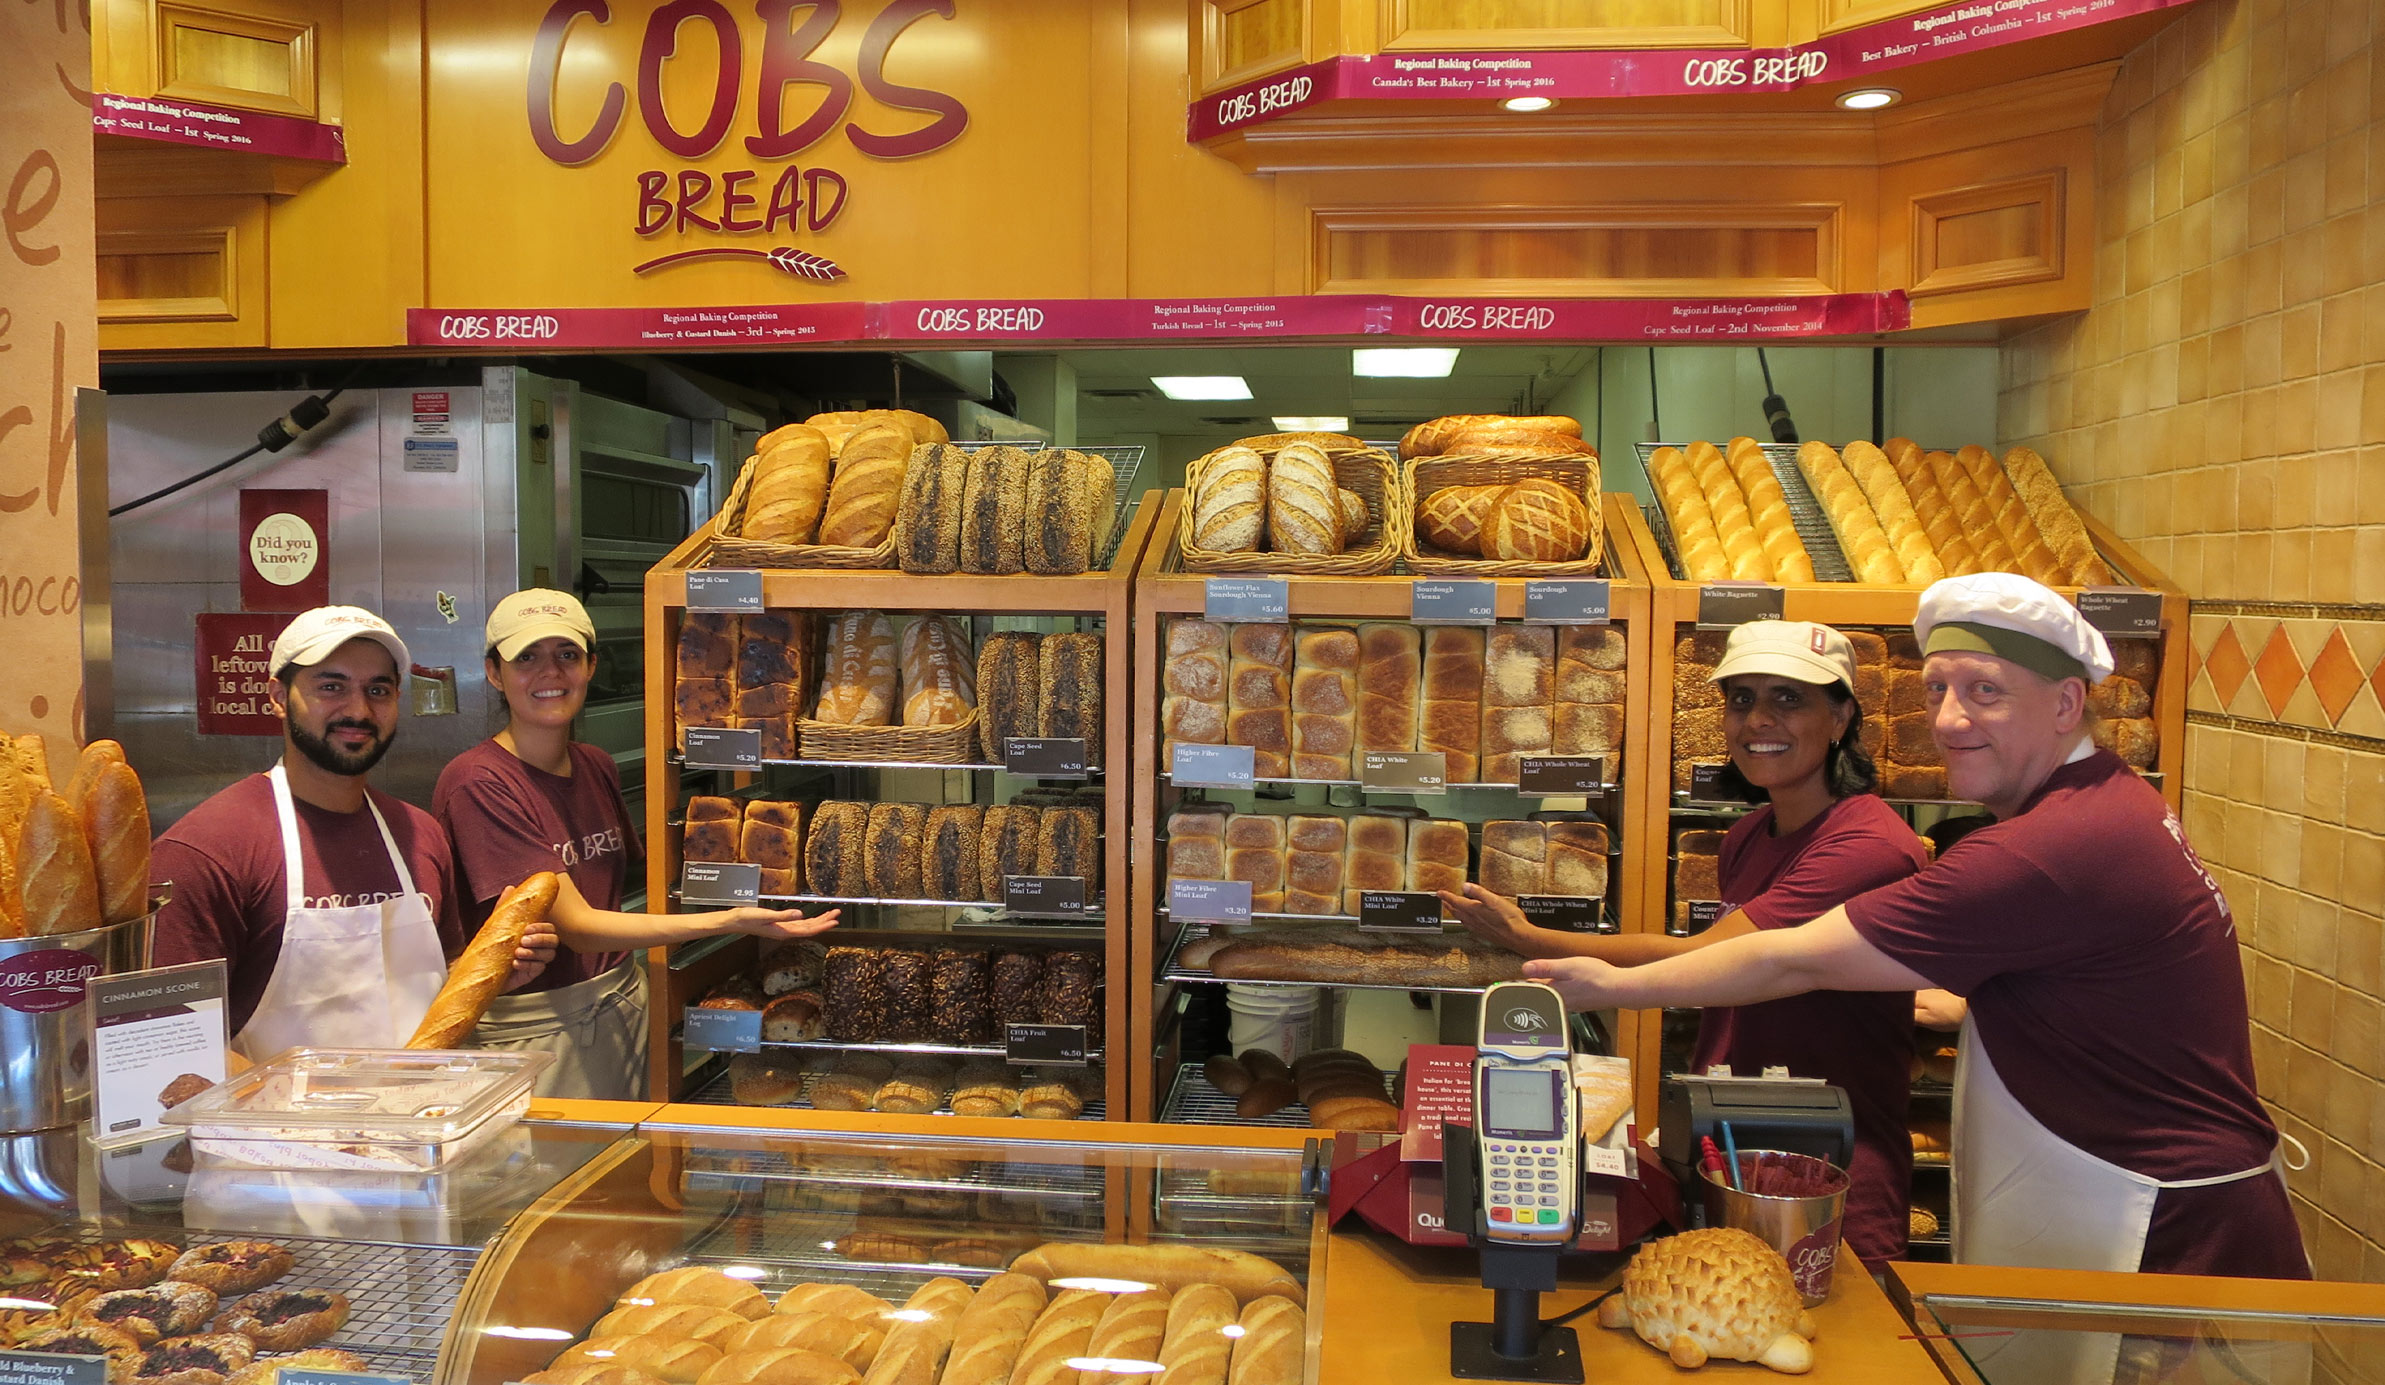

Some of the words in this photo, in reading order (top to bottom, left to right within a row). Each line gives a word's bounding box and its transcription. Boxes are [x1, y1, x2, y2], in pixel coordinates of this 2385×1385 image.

[1913, 13, 1956, 32] Regional
[1957, 4, 1994, 26] Baking
[1861, 51, 1881, 62] Best
[1884, 43, 1918, 57] Bakery
[1932, 29, 1967, 46] British
[1971, 17, 2022, 37] Columbia
[2035, 10, 2052, 23] 1st
[2056, 5, 2087, 20] Spring
[1394, 57, 1435, 71] Regional
[1437, 57, 1470, 71] Baking
[1472, 58, 1531, 71] Competition
[1683, 58, 1746, 86] COBS
[1752, 51, 1827, 85] BREAD
[526, 0, 968, 164] COBS
[1372, 76, 1413, 87] Canada's
[1416, 77, 1436, 87] Best
[1439, 77, 1474, 90] Bakery
[1486, 75, 1501, 87] 1st
[1504, 77, 1531, 89] Spring
[1533, 77, 1554, 86] 2016
[1218, 92, 1255, 125] COBS
[1259, 77, 1312, 113] BREAD
[102, 96, 146, 111] Regional
[147, 102, 181, 118] Baking
[182, 107, 240, 124] Competition
[93, 115, 117, 131] Cape
[119, 118, 144, 129] Seed
[148, 121, 170, 133] Loaf
[184, 125, 198, 137] 1st
[203, 130, 229, 143] Spring
[231, 134, 251, 143] 2016
[634, 164, 850, 236] BREAD
[1154, 304, 1190, 316] Regional
[1192, 304, 1221, 315] Baking
[1223, 302, 1275, 314] Competition
[1672, 305, 1709, 317] Regional
[1712, 304, 1742, 316] Baking
[1743, 302, 1797, 315] Competition
[663, 313, 697, 324] Regional
[699, 312, 727, 323] Baking
[728, 310, 778, 323] Competition
[917, 307, 971, 331] COBS
[975, 306, 1043, 331] BREAD
[1420, 304, 1476, 328] COBS
[1481, 306, 1554, 329] BREAD
[440, 315, 490, 338] COBS
[494, 315, 558, 338] BREAD
[1214, 318, 1226, 328] 1st
[1238, 320, 1262, 330] Spring
[1265, 319, 1284, 327] 2015
[1643, 325, 1666, 336] Cape
[1670, 324, 1691, 334] Seed
[1695, 324, 1715, 333] Loaf
[1727, 322, 1748, 333] 2nd
[1752, 322, 1800, 332] November
[1802, 321, 1823, 331] 2014
[745, 326, 762, 336] 3rd
[772, 327, 795, 337] Spring
[256, 536, 283, 552] Did
[285, 540, 312, 551] you
[259, 551, 307, 563] know?
[689, 576, 705, 584] Pane
[1208, 590, 1246, 599] Sourdough
[1416, 585, 1454, 594] Sourdough
[1528, 586, 1567, 594] Sourdough
[1726, 590, 1758, 598] Baguette
[2080, 596, 2103, 605] Whole
[2080, 604, 2111, 612] Baguette
[1757, 612, 1781, 620] $2.90
[2134, 618, 2157, 626] $2.90
[232, 634, 264, 652] All
[218, 676, 237, 694] is
[207, 696, 258, 715] local
[688, 732, 720, 741] Cinnamon
[1009, 742, 1025, 750] Cape
[736, 754, 757, 763] $5.20
[1177, 748, 1200, 759] Higher
[1366, 756, 1386, 764] CHIA
[1523, 761, 1543, 769] CHIA
[1227, 771, 1249, 779] $5.20
[687, 867, 720, 875] Cinnamon
[1008, 881, 1025, 889] Cape
[1174, 884, 1198, 893] Higher
[1198, 884, 1217, 893] Fibre
[734, 889, 754, 897] $2.95
[1364, 896, 1384, 904] CHIA
[1693, 912, 1711, 920] Mini
[1573, 920, 1596, 928] $3.20
[44, 964, 98, 986] BREAD
[102, 988, 164, 1004] CINNAMON
[166, 981, 200, 994] SCONE
[1009, 1029, 1028, 1037] CHIA
[1596, 1162, 1620, 1171] $4.40
[12, 1361, 64, 1376] Blueberry
[65, 1364, 75, 1375] &
[28, 1375, 65, 1385] Danish
